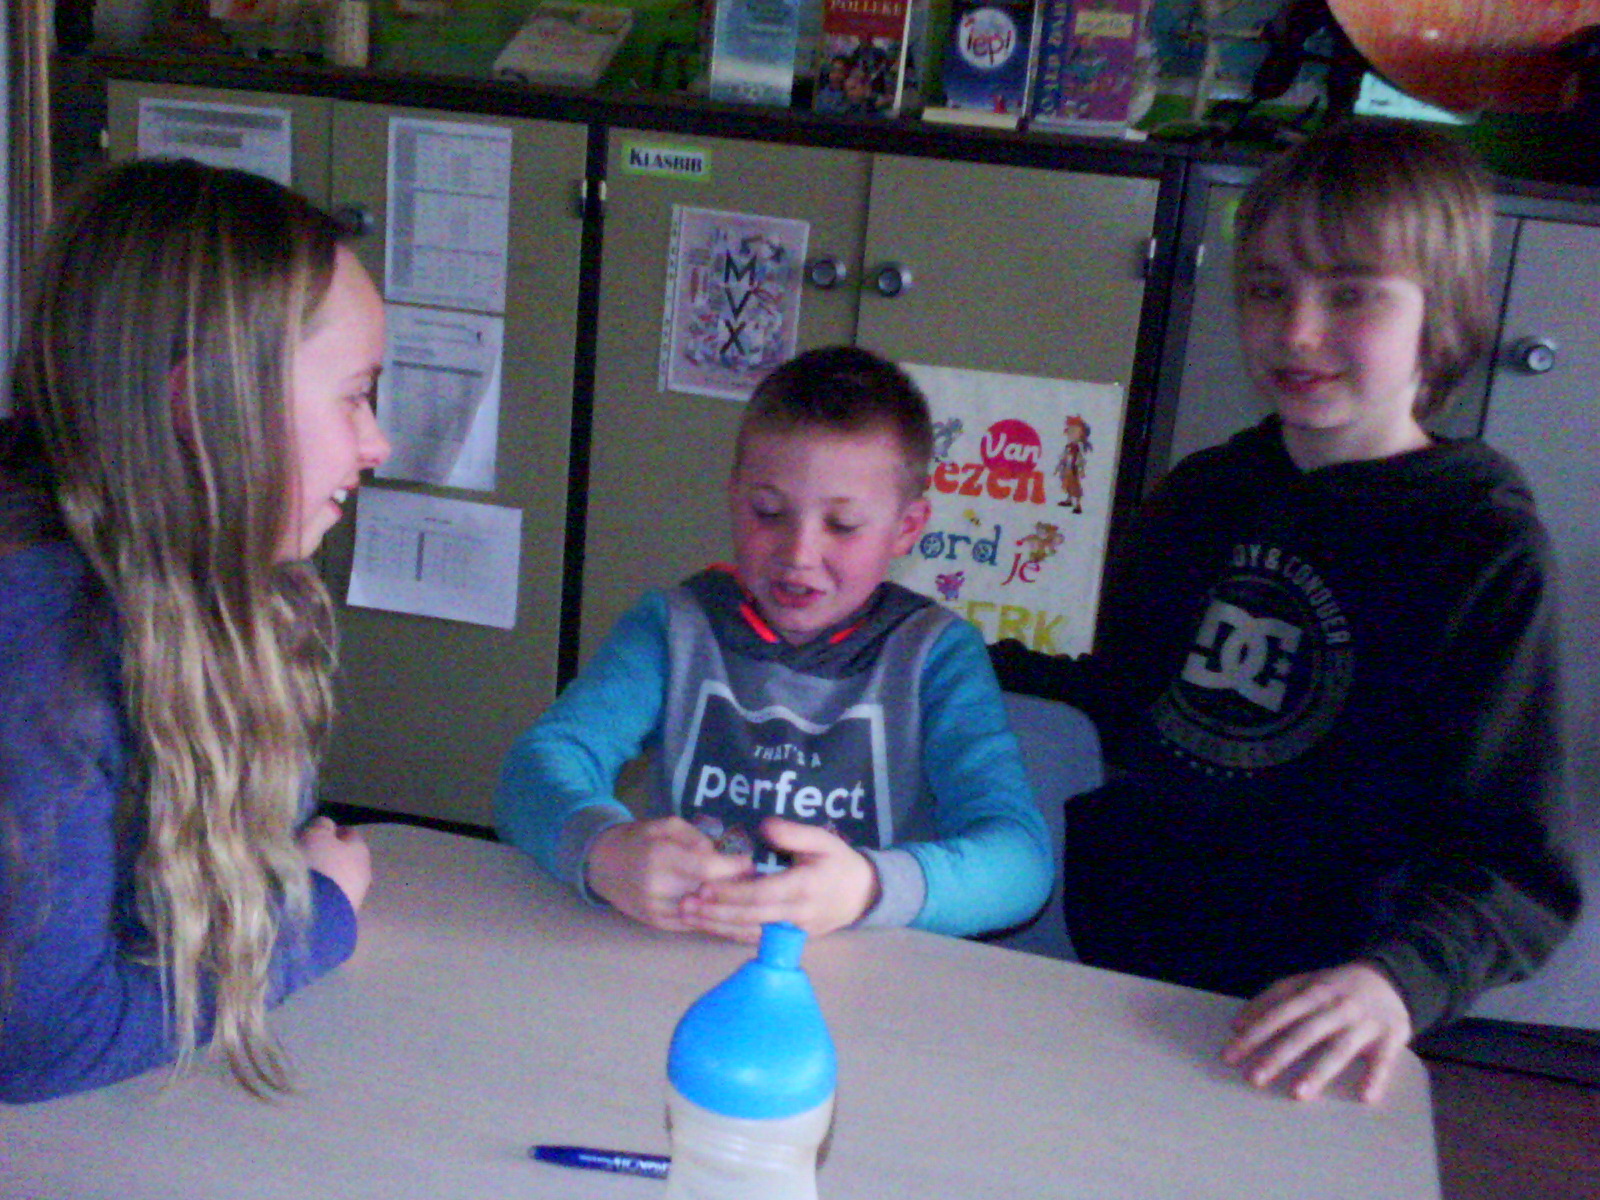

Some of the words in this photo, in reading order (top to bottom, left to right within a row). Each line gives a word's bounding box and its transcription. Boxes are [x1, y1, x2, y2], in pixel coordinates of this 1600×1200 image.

[984, 431, 1041, 468] Van
[926, 461, 1046, 505] ezen
[908, 523, 1001, 566] ord
[1001, 539, 1041, 586] je
[811, 752, 822, 768] A
[693, 763, 865, 819] perfect
